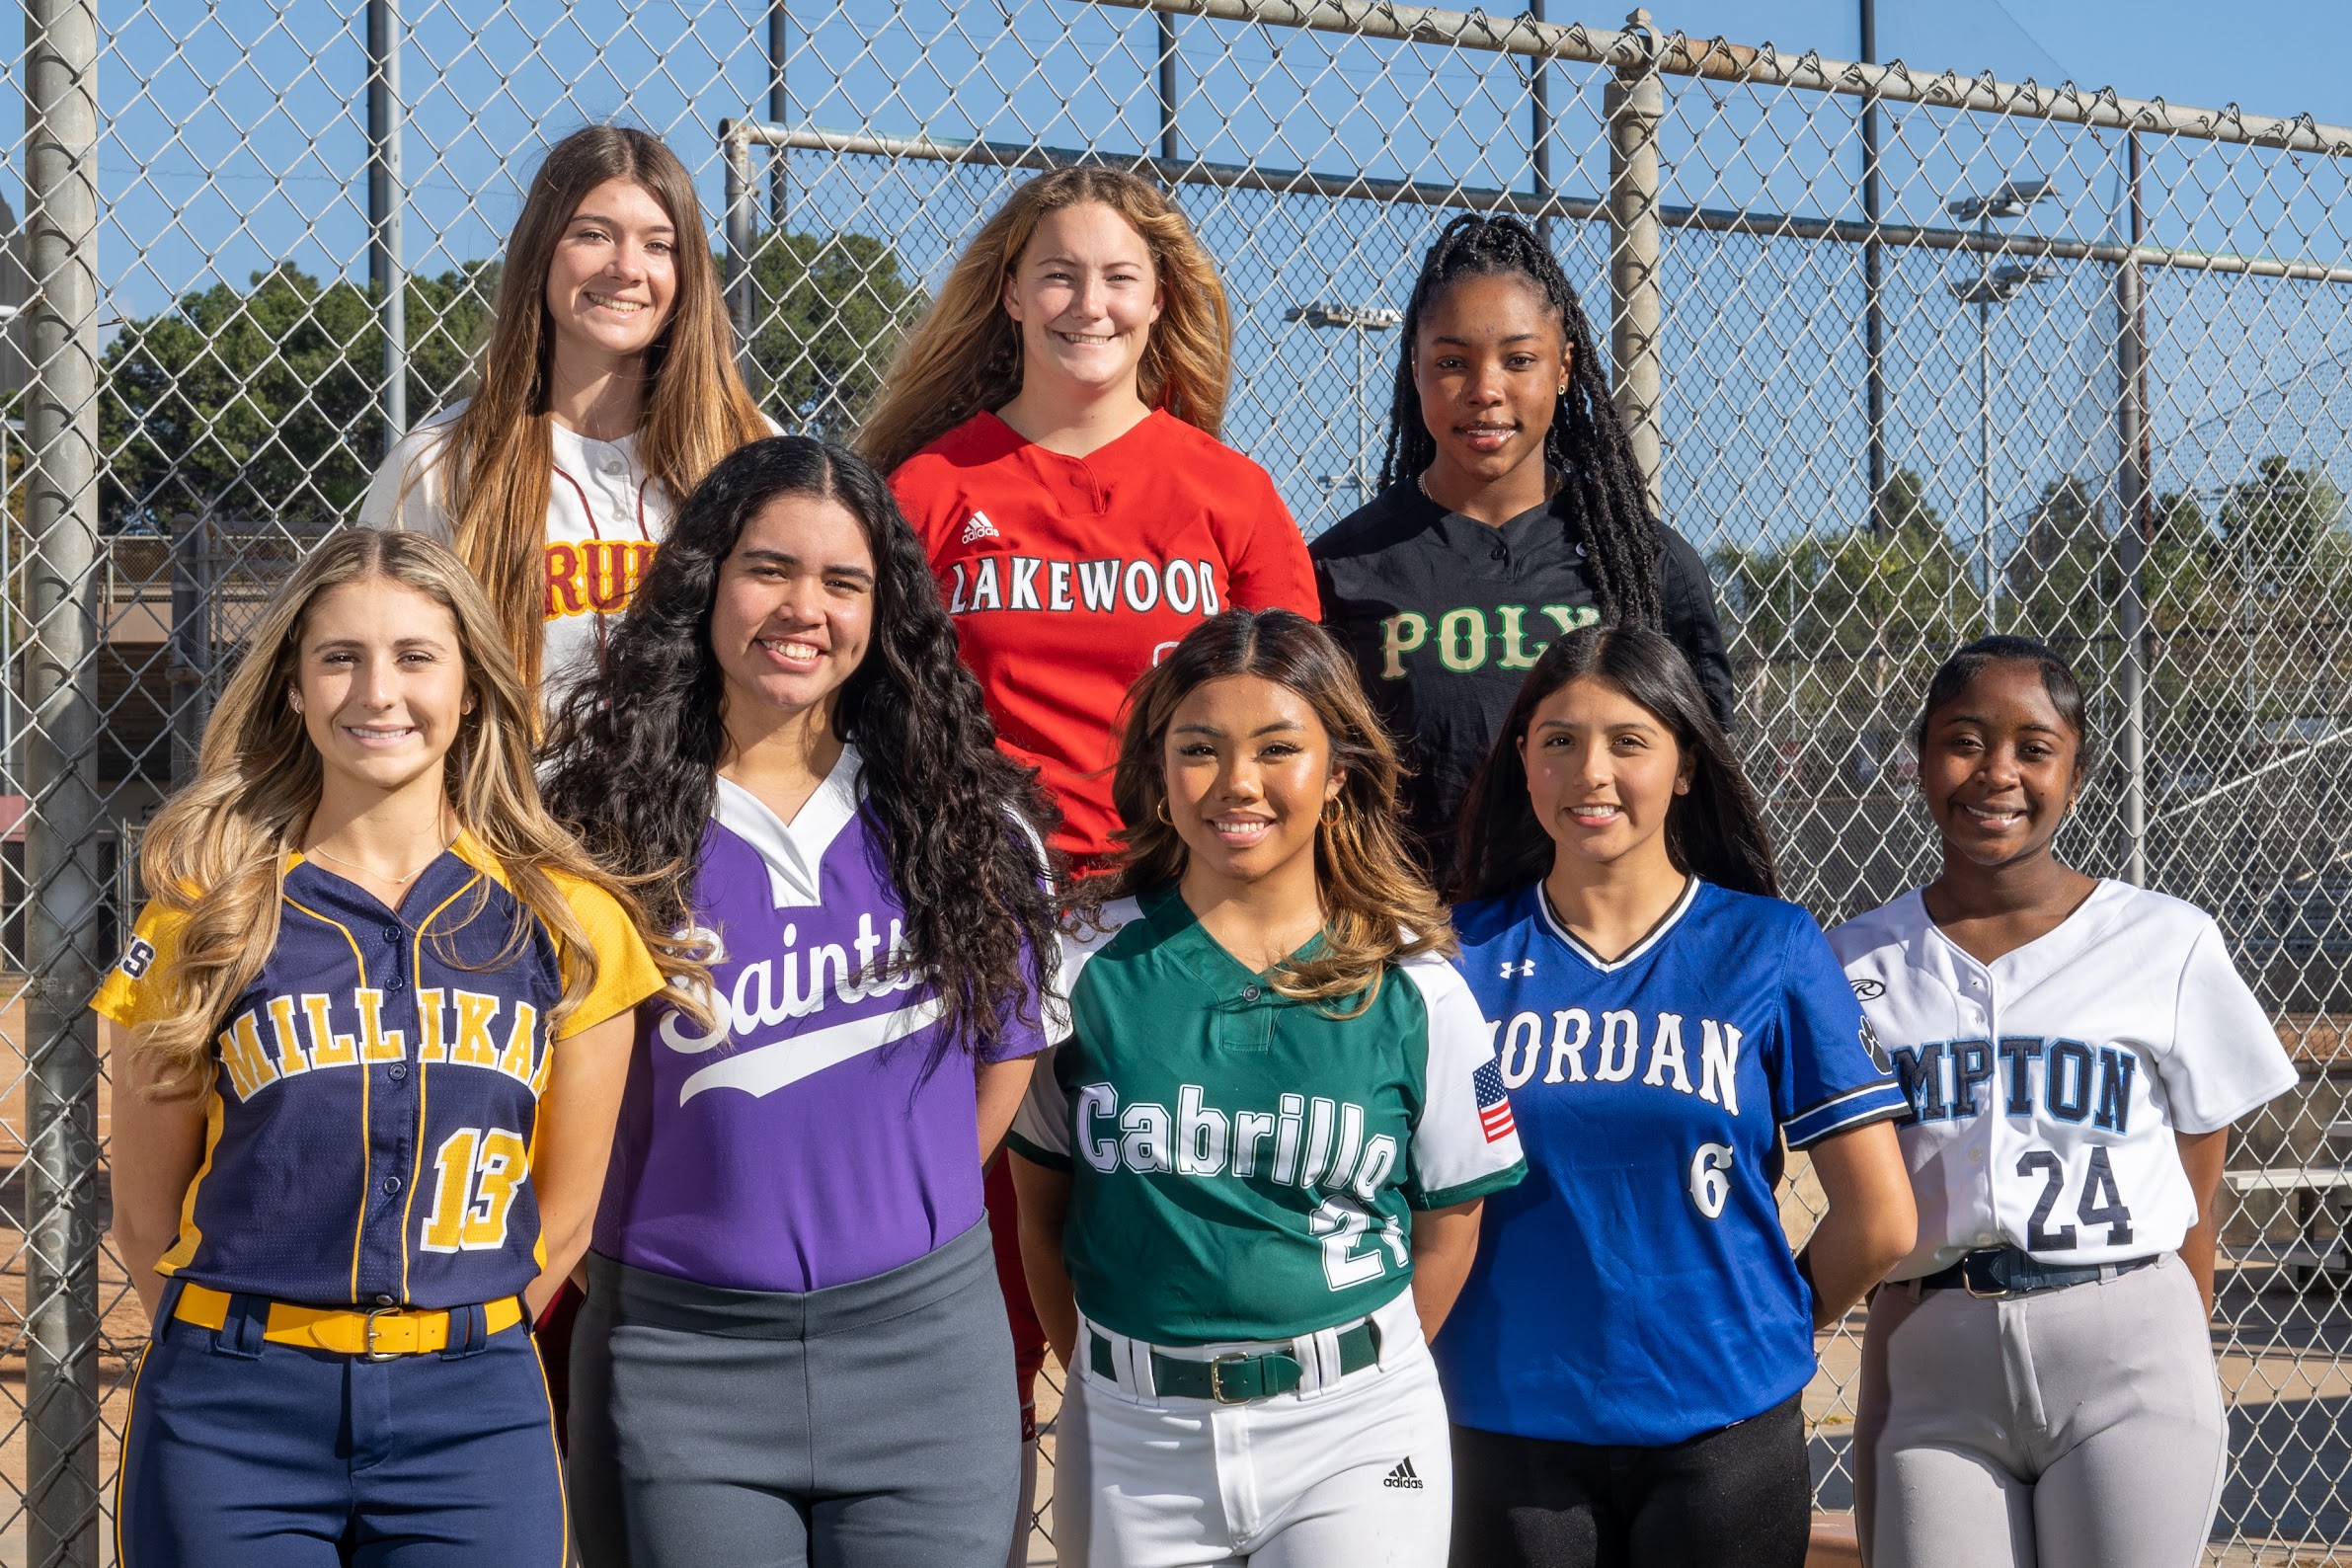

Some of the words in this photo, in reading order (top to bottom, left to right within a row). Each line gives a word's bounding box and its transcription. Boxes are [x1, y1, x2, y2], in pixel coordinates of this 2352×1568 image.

[962, 526, 999, 544] adidas
[949, 555, 1220, 617] LAKEWOOD
[1485, 1007, 1745, 1117] ORDAN
[1076, 1082, 1398, 1202] Cabrillo
[1688, 1141, 1735, 1219] 6
[420, 1128, 529, 1254] 13
[2015, 1145, 2134, 1252] 24
[1383, 1475, 1424, 1489] adidas
